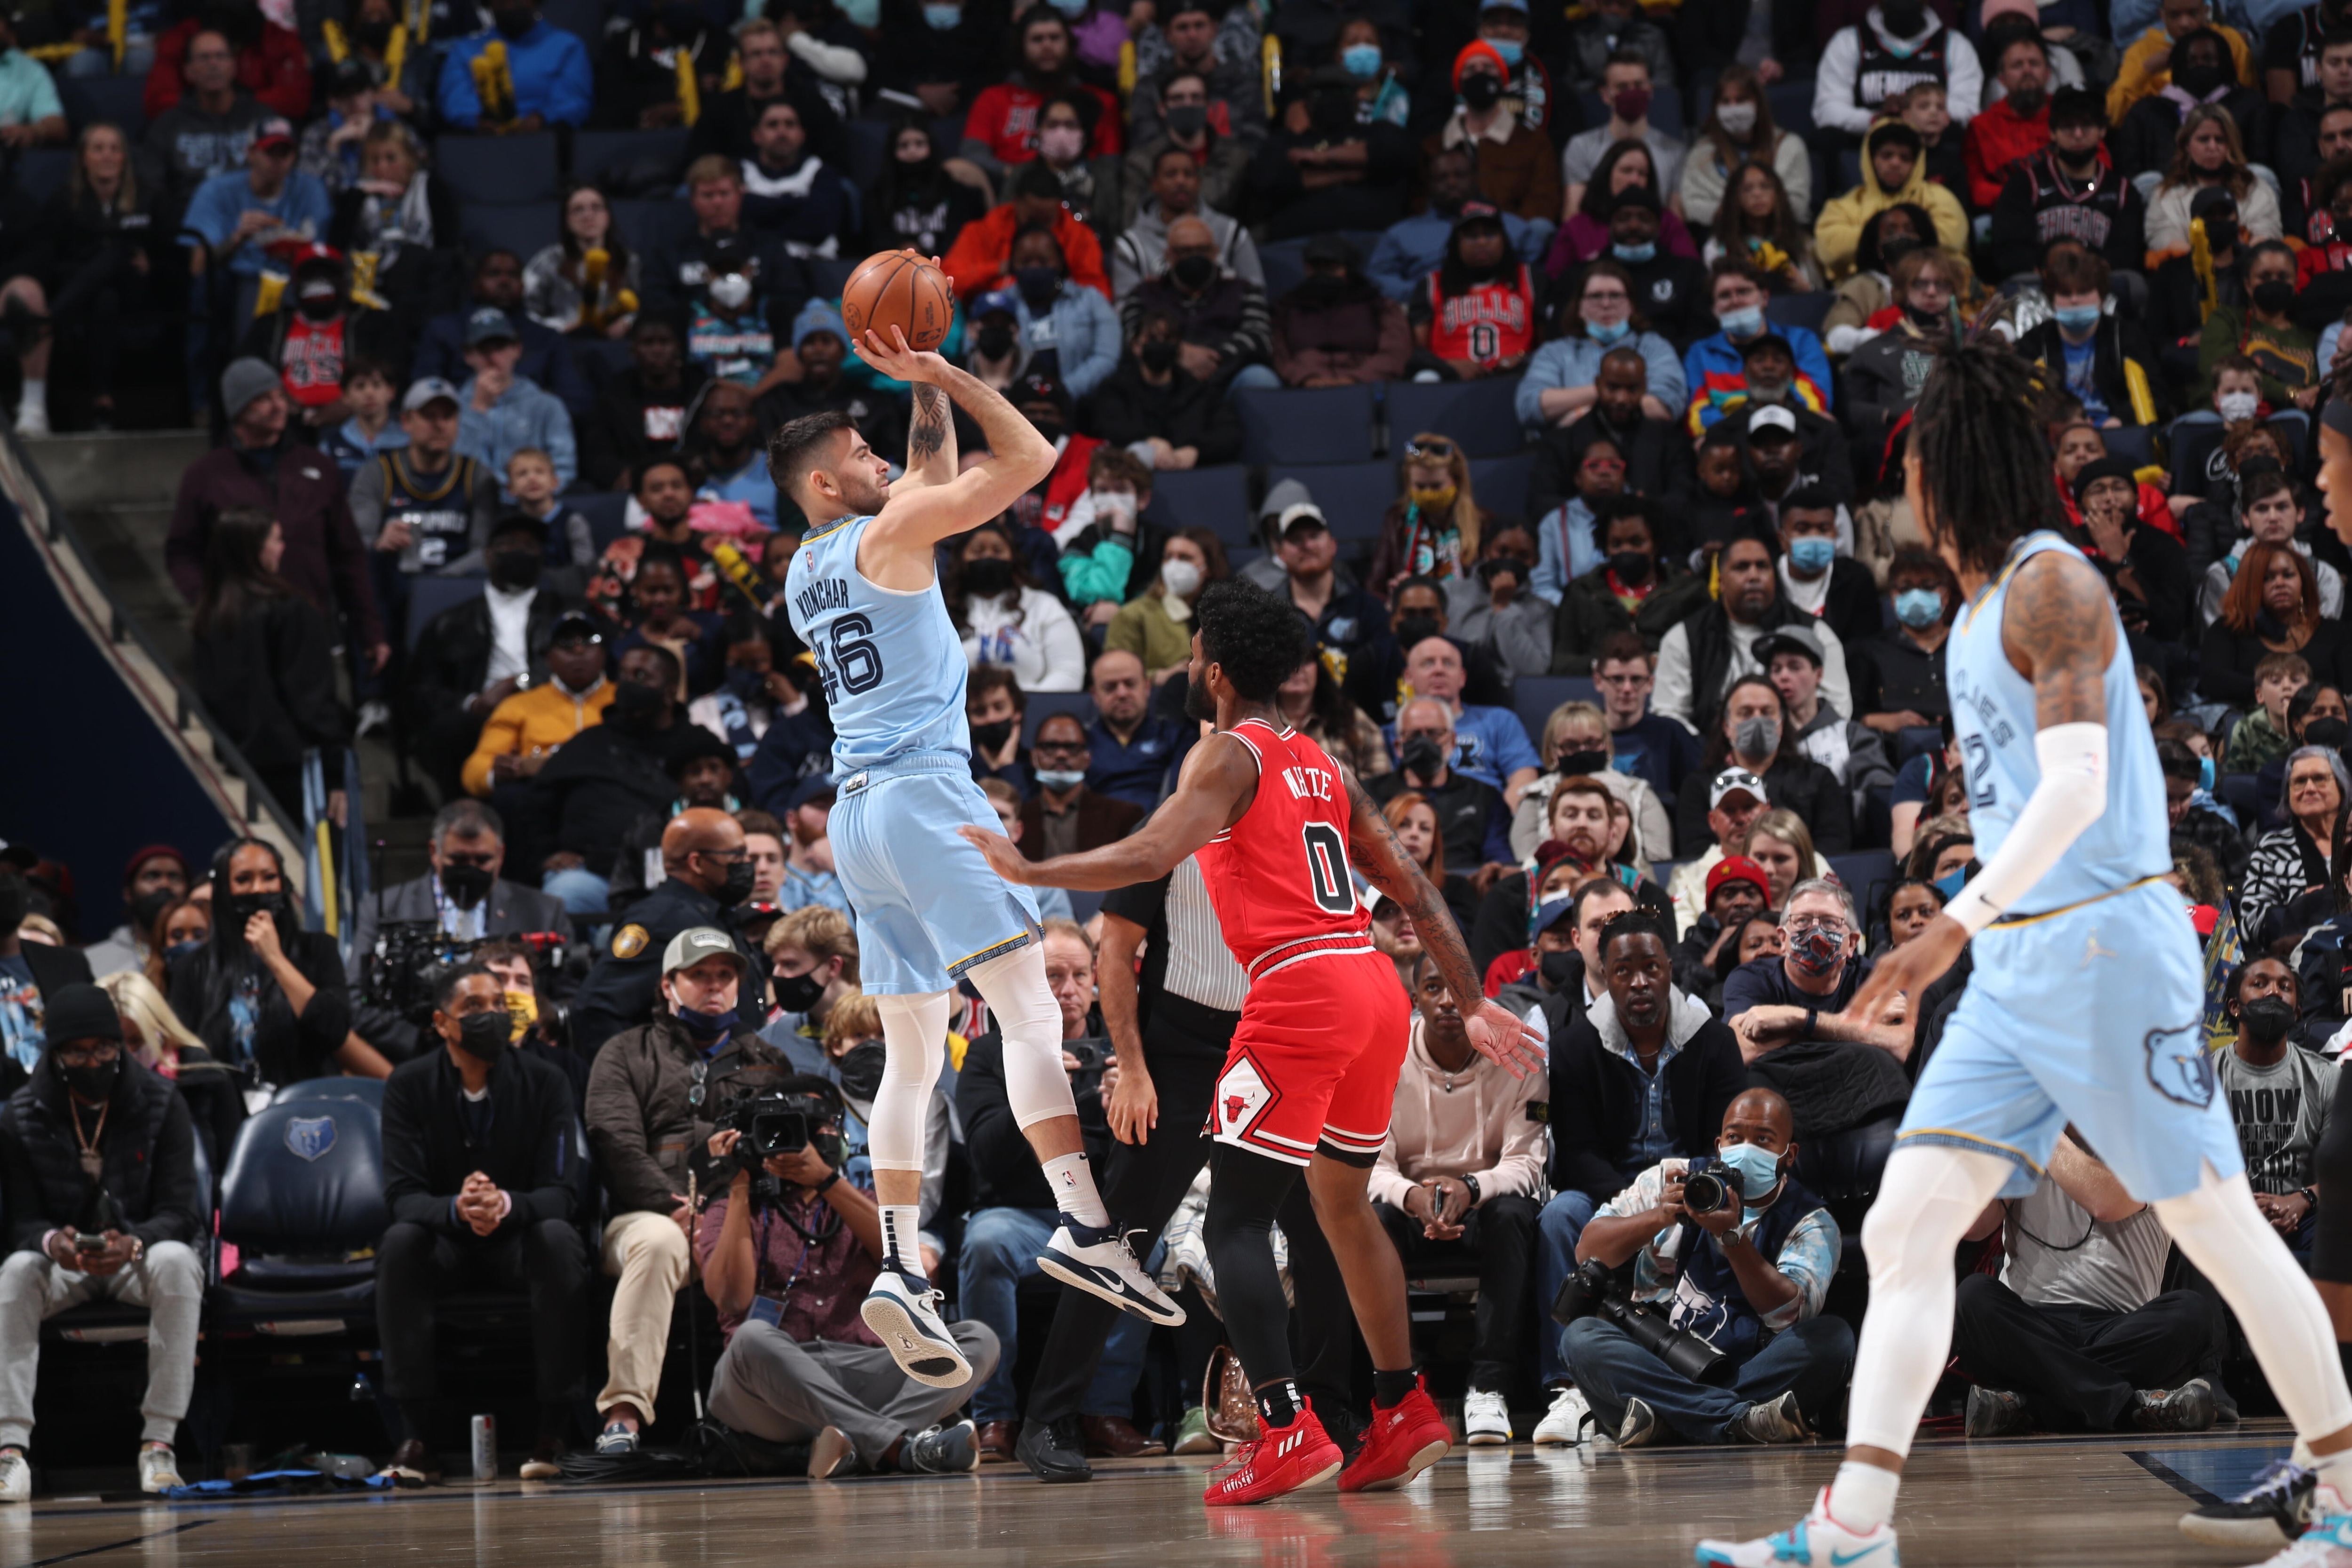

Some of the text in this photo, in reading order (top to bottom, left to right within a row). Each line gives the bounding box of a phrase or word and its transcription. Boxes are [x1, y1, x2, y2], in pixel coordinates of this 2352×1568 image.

[1443, 292, 1524, 334] BULLS
[795, 579, 849, 624] KONCHAR
[1282, 766, 1332, 803] WHTE
[1301, 820, 1358, 915] 0
[2231, 1088, 2301, 1124] NOW
[2240, 1125, 2249, 1140] IS
[2254, 1125, 2270, 1140] THE
[2246, 1141, 2257, 1156] TO
